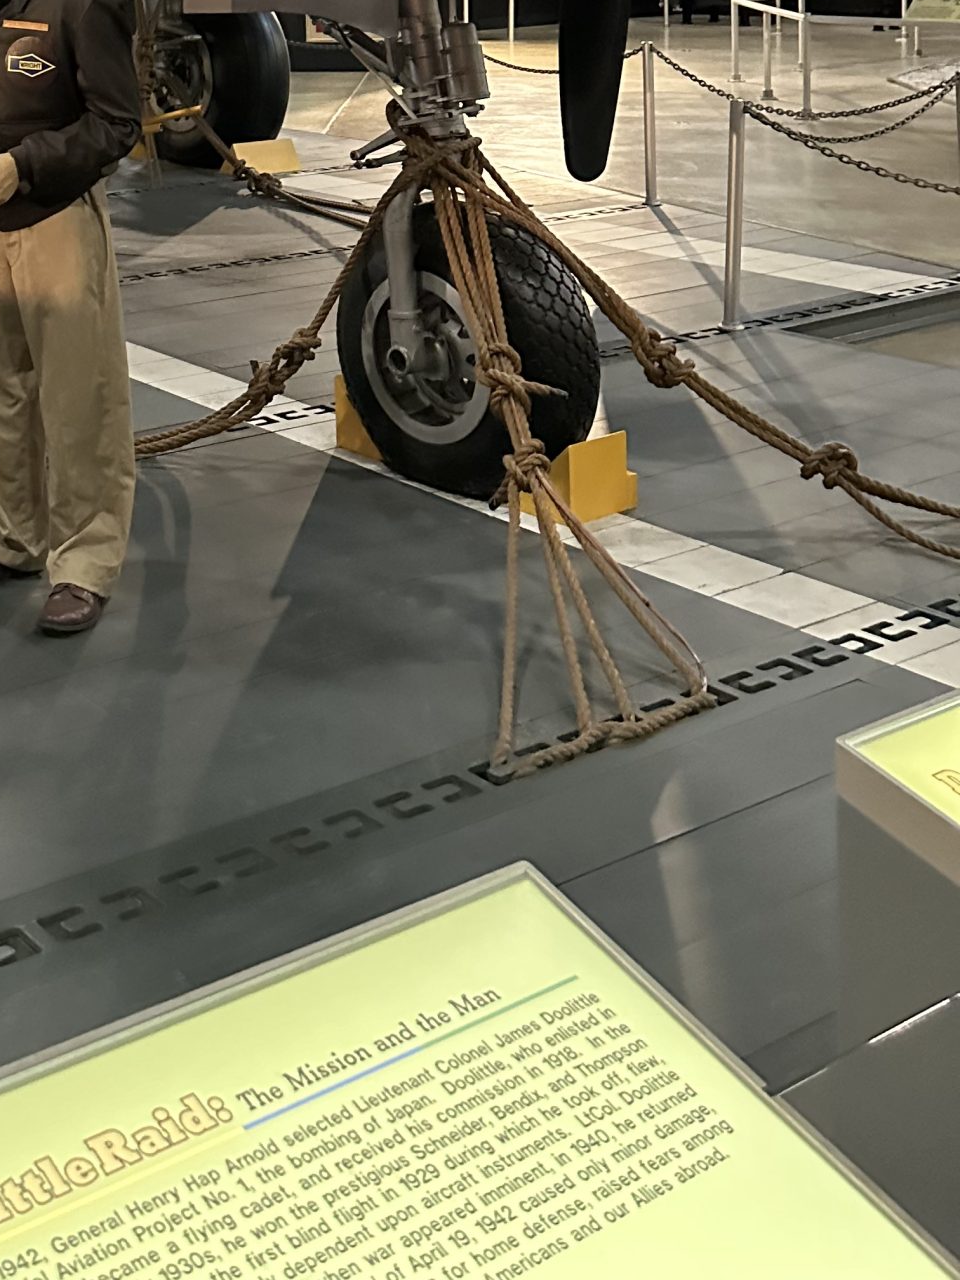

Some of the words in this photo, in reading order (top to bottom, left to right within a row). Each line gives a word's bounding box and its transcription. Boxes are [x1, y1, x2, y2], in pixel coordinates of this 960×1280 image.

[50, 1210, 125, 1254] General
[125, 1187, 180, 1220] Henry
[182, 1169, 221, 1193] Hap
[225, 1138, 281, 1174] Arnold
[283, 1105, 353, 1147] selected
[352, 1068, 435, 1114] Lieutenant
[435, 1040, 493, 1074] Colonel
[494, 1021, 541, 1048] James
[539, 994, 600, 1025] Doolittle
[56, 1238, 132, 1280] Aviation
[132, 1201, 201, 1243] Project
[201, 1191, 236, 1210] No.
[236, 1178, 256, 1193] 1,
[255, 1165, 286, 1184] the
[286, 1129, 362, 1169] bombing
[363, 1115, 382, 1134] of
[385, 1096, 437, 1124] Japan.
[440, 1060, 512, 1096] Doolittle,
[510, 1043, 543, 1062] who
[545, 1012, 601, 1047] enlisted
[597, 1008, 616, 1020] in
[166, 1241, 181, 1254] a
[183, 1214, 237, 1245] flying
[240, 1185, 297, 1219] cadet,
[298, 1164, 332, 1190] and
[334, 1129, 406, 1173] received
[404, 1119, 433, 1138] his
[436, 1075, 526, 1123] commission
[523, 1066, 544, 1079] in
[542, 1046, 583, 1070] 1918.
[585, 1036, 606, 1049] In
[603, 1024, 631, 1040] the
[235, 1087, 284, 1111] The
[282, 1045, 373, 1092] Mission
[373, 1021, 417, 1053] and
[415, 1012, 452, 1033] the
[447, 988, 503, 1018] Man
[158, 1251, 223, 1280] 1930s,
[220, 1236, 247, 1254] he
[250, 1216, 289, 1240] won
[289, 1201, 320, 1220] the
[322, 1156, 410, 1208] prestigious
[410, 1117, 494, 1160] Schneider,
[489, 1090, 549, 1120] Bendix,
[548, 1070, 577, 1093] and
[572, 1039, 648, 1077] Thompson
[245, 1242, 286, 1270] first
[285, 1217, 332, 1249] blind
[333, 1195, 380, 1226] flight
[378, 1188, 400, 1202] in
[398, 1164, 440, 1191] 1929
[444, 1140, 496, 1170] during
[494, 1115, 541, 1144] which
[537, 1106, 563, 1121] he
[562, 1085, 601, 1109] took
[600, 1071, 631, 1091] off,
[626, 1056, 666, 1077] flew,
[283, 1224, 375, 1280] dependent
[375, 1205, 420, 1232] upon
[421, 1171, 480, 1209] aircraft
[476, 1128, 572, 1179] instruments.
[574, 1099, 622, 1128] LtCol.
[618, 1071, 680, 1106] Doolittle
[362, 1243, 395, 1266] war
[400, 1198, 478, 1248] appeared
[475, 1161, 556, 1206] imminent,
[550, 1153, 572, 1167] in
[570, 1129, 617, 1156] 1940,
[611, 1119, 636, 1134] he
[637, 1083, 698, 1123] returned
[386, 1263, 405, 1280] of
[408, 1241, 449, 1273] April
[448, 1230, 478, 1249] 19,
[474, 1205, 518, 1234] 1942
[519, 1173, 576, 1213] caused
[577, 1158, 611, 1181] only
[610, 1135, 652, 1163] minor
[654, 1105, 717, 1139] damage,
[441, 1262, 470, 1280] for
[469, 1236, 520, 1267] home
[523, 1200, 593, 1239] defense,
[592, 1166, 641, 1202] raised
[639, 1148, 682, 1174] fears
[682, 1120, 734, 1152] among
[570, 1215, 603, 1242] and
[604, 1202, 630, 1223] our
[630, 1180, 673, 1208] Allies
[674, 1146, 730, 1184] abroad.
